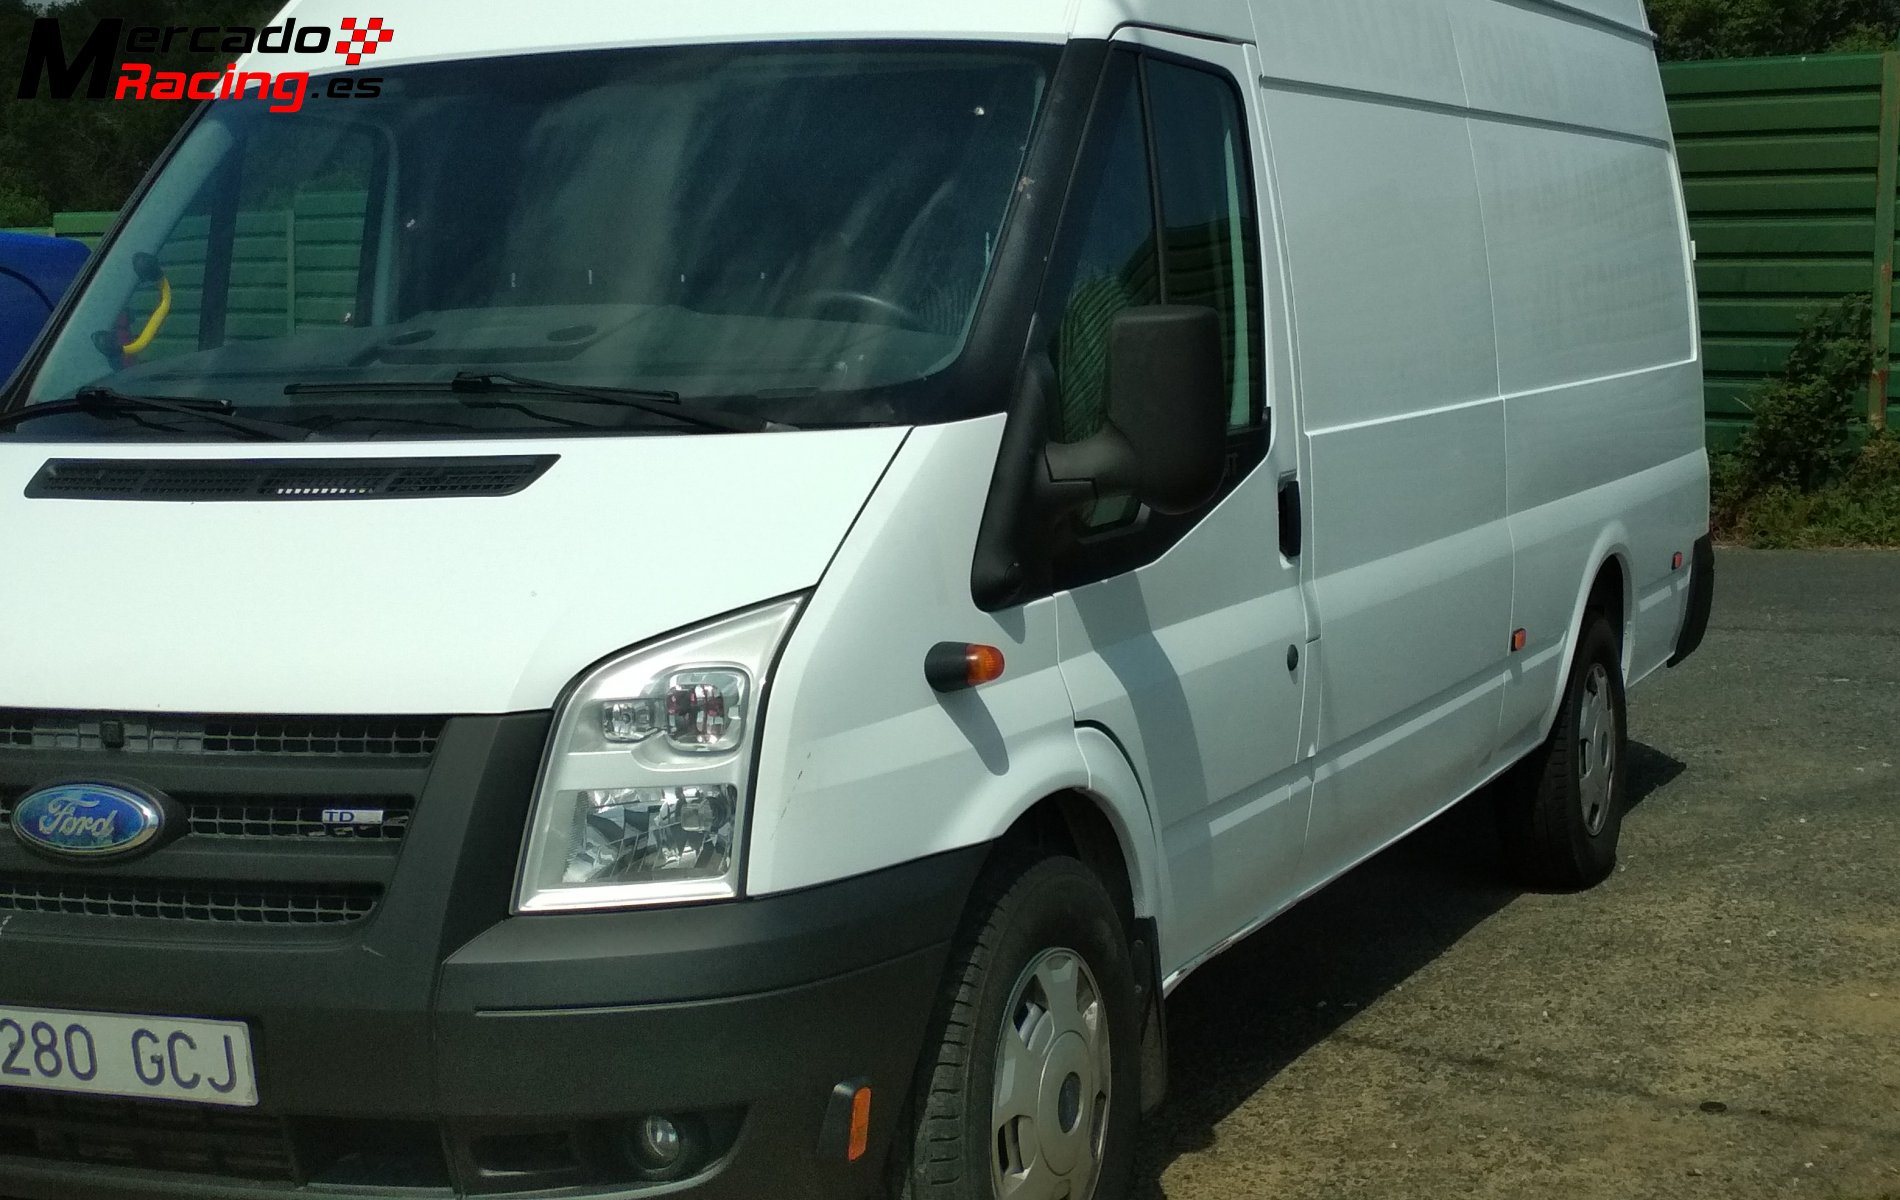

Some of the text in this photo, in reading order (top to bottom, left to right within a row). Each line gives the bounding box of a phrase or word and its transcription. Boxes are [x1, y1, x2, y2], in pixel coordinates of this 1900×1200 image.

[38, 796, 117, 837] Ford
[0, 1018, 237, 1094] 280 GCJ
